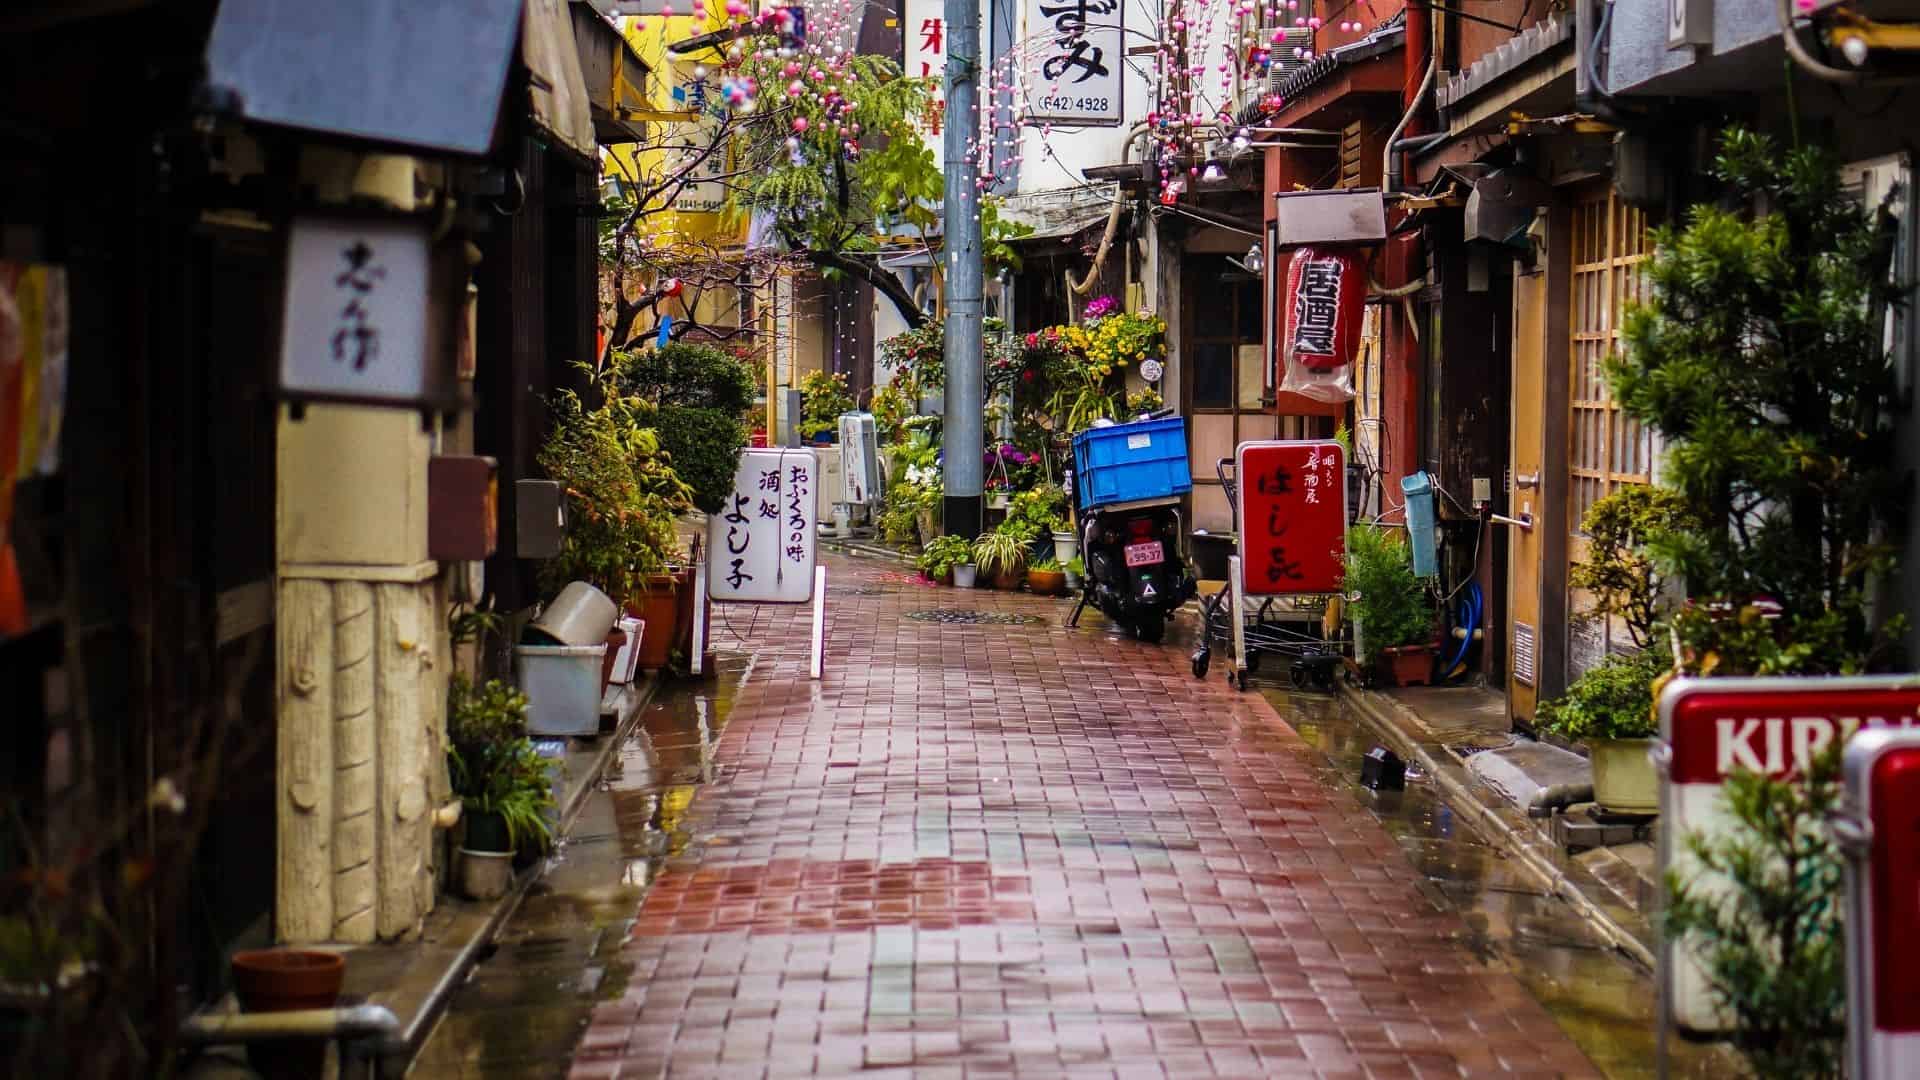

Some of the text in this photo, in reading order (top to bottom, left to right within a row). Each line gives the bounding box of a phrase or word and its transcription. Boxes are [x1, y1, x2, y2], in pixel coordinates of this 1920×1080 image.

[1292, 261, 1342, 356] 居酒屋
[725, 492, 753, 590] よし子
[759, 471, 780, 519] 酒処
[786, 465, 809, 563] おふくろの味
